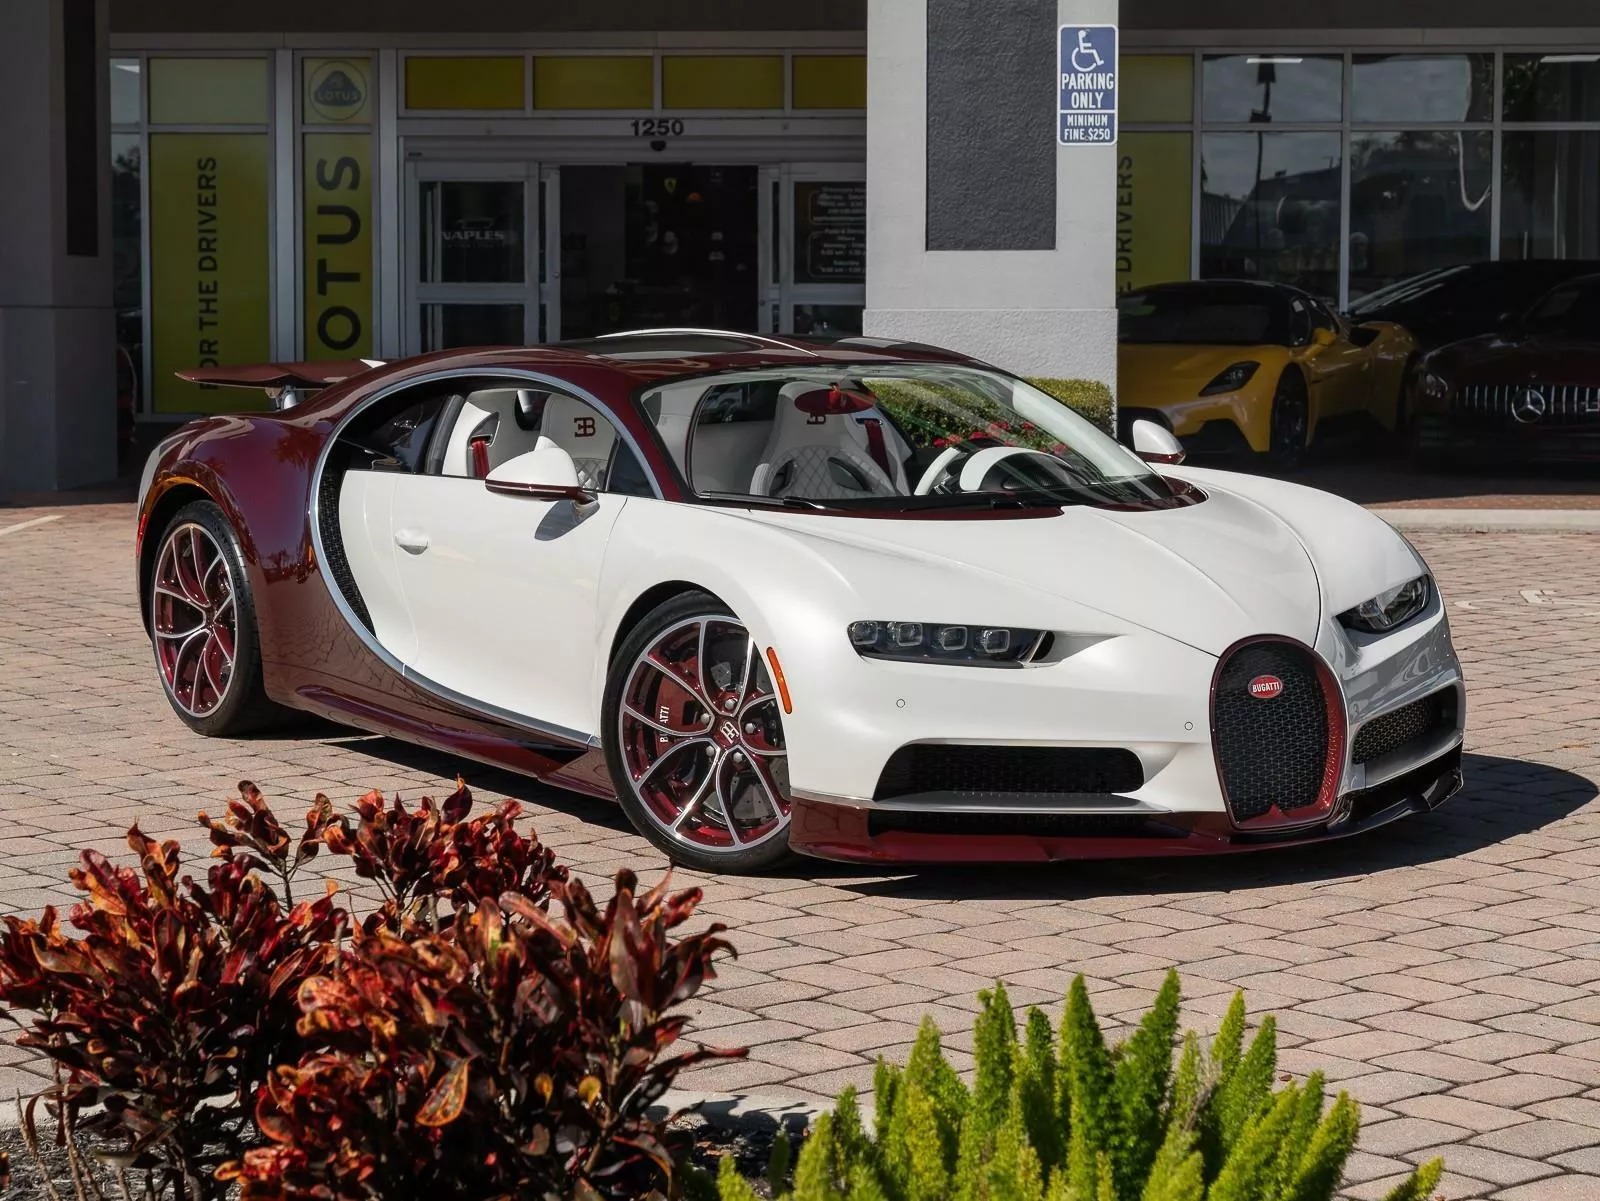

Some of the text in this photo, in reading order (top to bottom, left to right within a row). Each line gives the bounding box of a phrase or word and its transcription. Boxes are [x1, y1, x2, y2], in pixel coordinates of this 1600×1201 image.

[1061, 73, 1114, 90] PARKING
[317, 91, 359, 101] LOTUS
[1071, 92, 1104, 109] ONLY
[630, 119, 684, 136] 1250
[1067, 114, 1108, 126] MINIMUM
[1064, 128, 1110, 140] FINE $250
[198, 157, 217, 271] DRIVERS
[1116, 156, 1132, 272] DRIVERS
[441, 231, 505, 241] NAPLES
[316, 156, 361, 351] OTUS
[198, 281, 218, 330] THE
[1252, 681, 1280, 693] BUGATTI
[659, 705, 670, 743] BATTI
